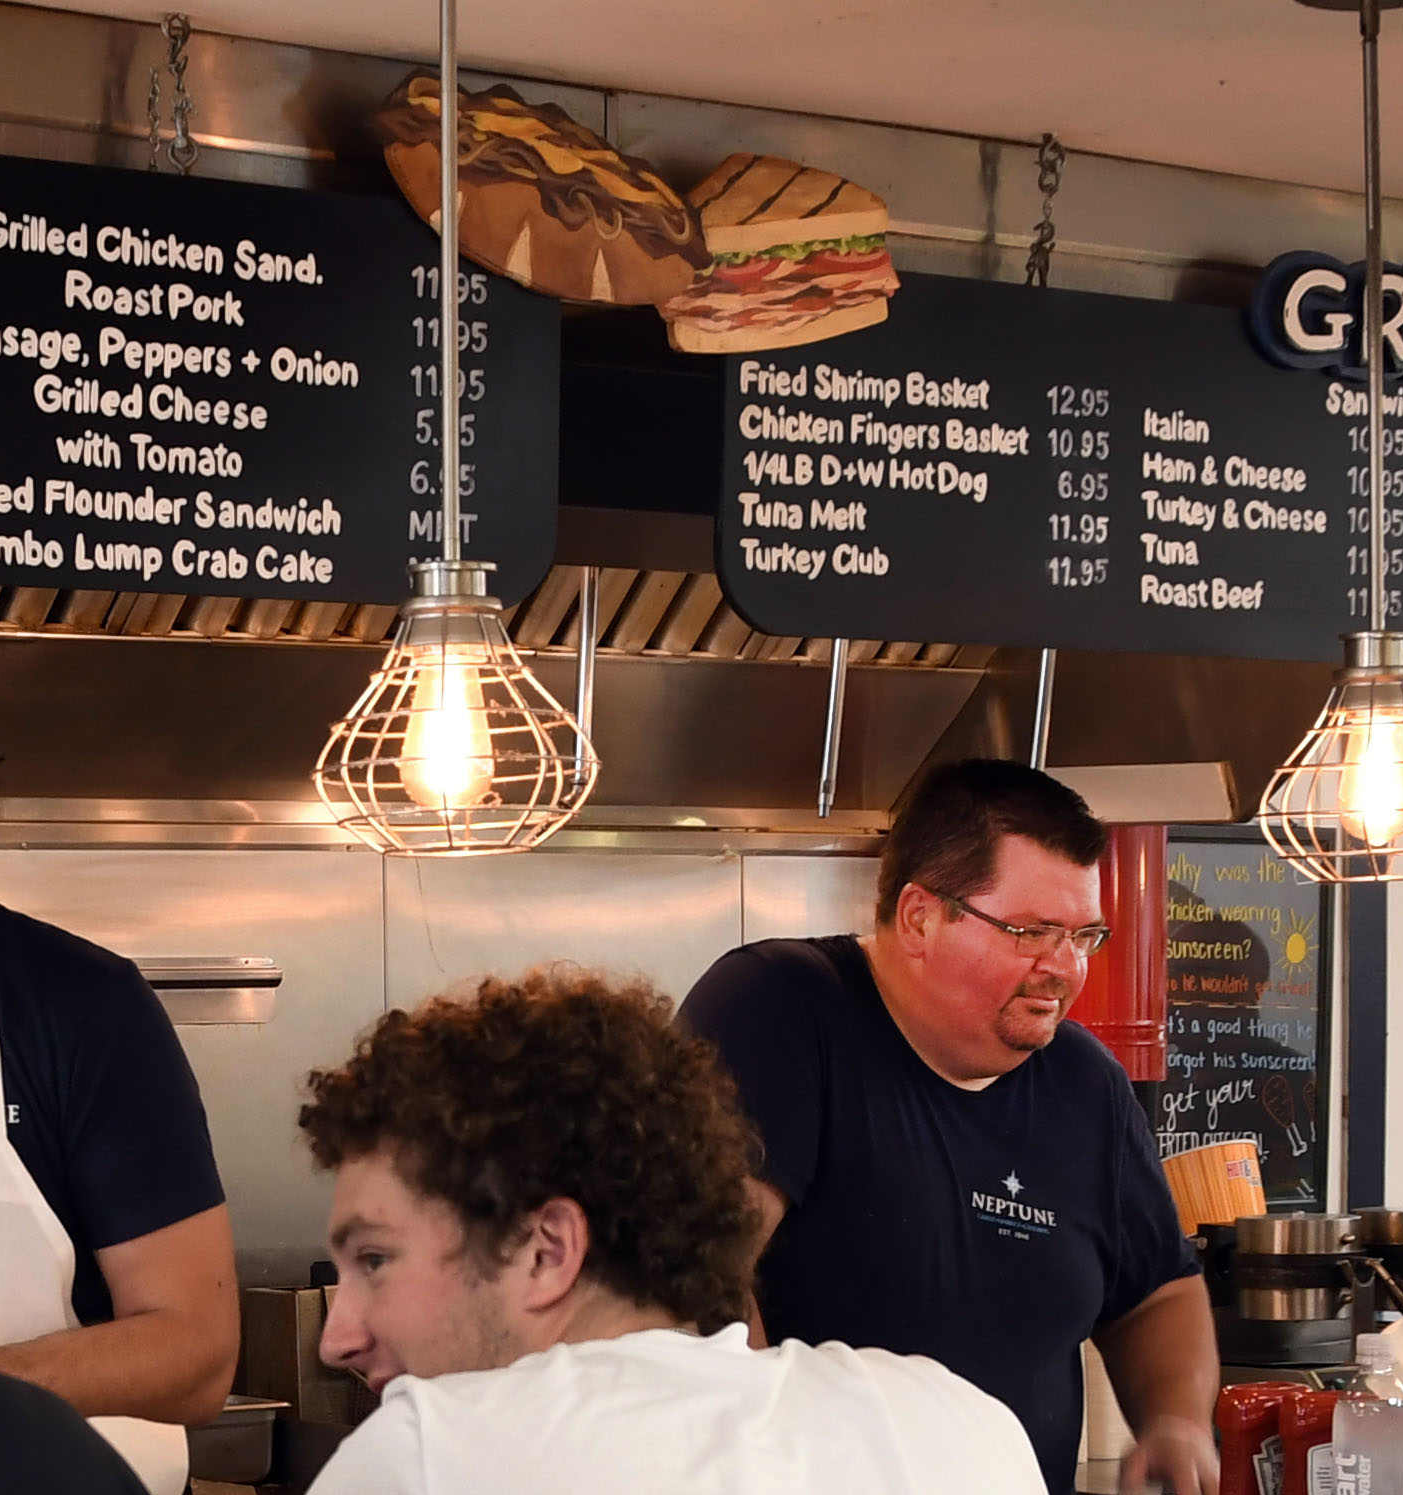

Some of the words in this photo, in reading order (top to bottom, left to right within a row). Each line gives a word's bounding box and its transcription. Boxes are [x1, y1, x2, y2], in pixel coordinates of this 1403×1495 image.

[96, 225, 224, 275] Chicken
[233, 239, 324, 285] Sand.
[64, 269, 164, 317] Roast
[167, 283, 245, 327] Pork
[98, 326, 232, 379] Peppers
[240, 349, 261, 374] +
[270, 346, 359, 388] Onion
[33, 373, 143, 420] Grilled
[148, 383, 268, 430] Cheese
[739, 360, 807, 397] Fried
[813, 364, 901, 409] Shrimp
[905, 371, 990, 411] Basket
[1046, 385, 1110, 418] 12.95
[738, 404, 844, 445] Chicken
[850, 411, 940, 455] Fingers
[945, 418, 1030, 456] Basket
[1047, 428, 1110, 461] 10.95
[1143, 407, 1210, 444] Italian
[55, 432, 122, 470] with
[129, 433, 243, 478] Tomato
[743, 450, 814, 487] 1/4LB
[820, 454, 885, 488] D+W
[889, 458, 936, 491] Hot
[937, 461, 988, 503] Dog
[1057, 470, 1109, 502] 6.95
[1142, 451, 1196, 484] Ham
[1200, 455, 1219, 486] &
[1224, 455, 1307, 493] Cheese
[44, 479, 188, 526] Flounder
[194, 491, 342, 536] Sandwich
[737, 492, 804, 530] Tuna
[810, 499, 868, 531] Melt
[1048, 513, 1110, 544] 11.95
[1140, 490, 1217, 532] Turkey
[1222, 498, 1240, 530] &
[1243, 499, 1327, 534] Cheese
[74, 532, 163, 582] Lump
[171, 539, 249, 580] Crab
[255, 545, 334, 584] Cake
[739, 538, 827, 580] Turkey
[832, 543, 890, 576] Club
[1048, 556, 1109, 587] 11.95
[1140, 532, 1200, 566] Tuna
[1141, 574, 1209, 609] Roast
[1211, 577, 1264, 610] Beef
[1167, 852, 1202, 894] Why
[1215, 865, 1250, 882] was
[1257, 853, 1285, 883] the
[1219, 905, 1281, 934] wearing
[1191, 1019, 1201, 1034] a
[1207, 1017, 1241, 1043] good
[1247, 1018, 1289, 1047] thing
[1297, 1020, 1312, 1039] he
[1167, 1051, 1206, 1078] orgot
[1213, 1052, 1236, 1069] his
[1162, 1082, 1200, 1132] get
[1206, 1079, 1256, 1130] your
[972, 1191, 1057, 1227] NEPTUNE
